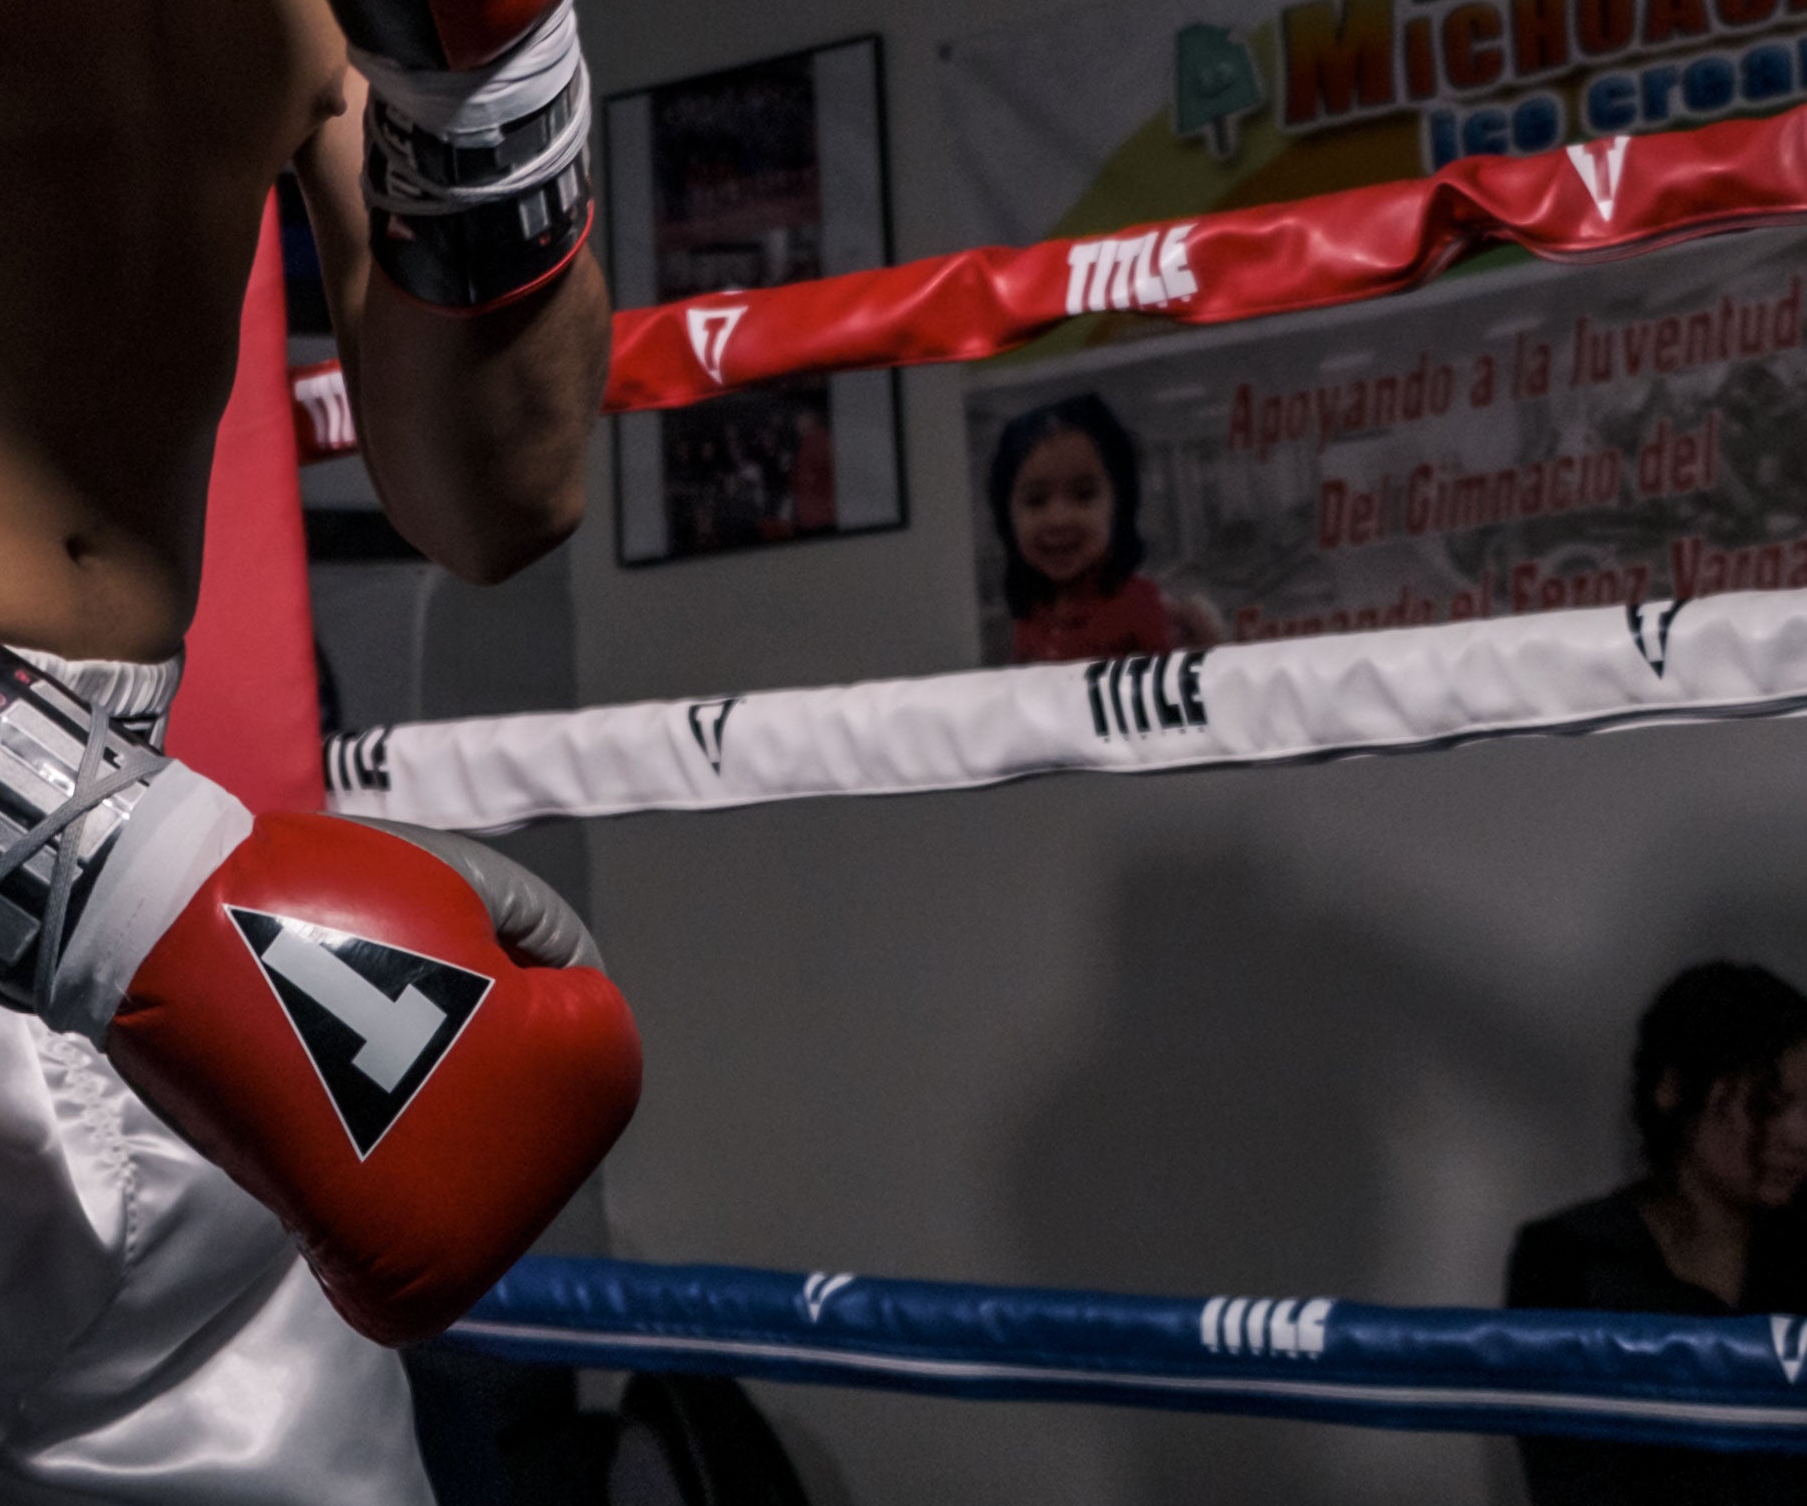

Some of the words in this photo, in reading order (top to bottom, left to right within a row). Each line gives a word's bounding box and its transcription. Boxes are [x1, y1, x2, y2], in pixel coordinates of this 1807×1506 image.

[1587, 37, 1807, 132] crea
[1066, 222, 1199, 315] TITLE
[1227, 351, 1453, 462] Apoyando
[1470, 354, 1495, 408] a
[1512, 331, 1553, 400] la
[1570, 275, 1803, 388] Juventud
[1318, 473, 1391, 550] Del
[1639, 410, 1722, 495] del
[1083, 651, 1208, 737] TITLE
